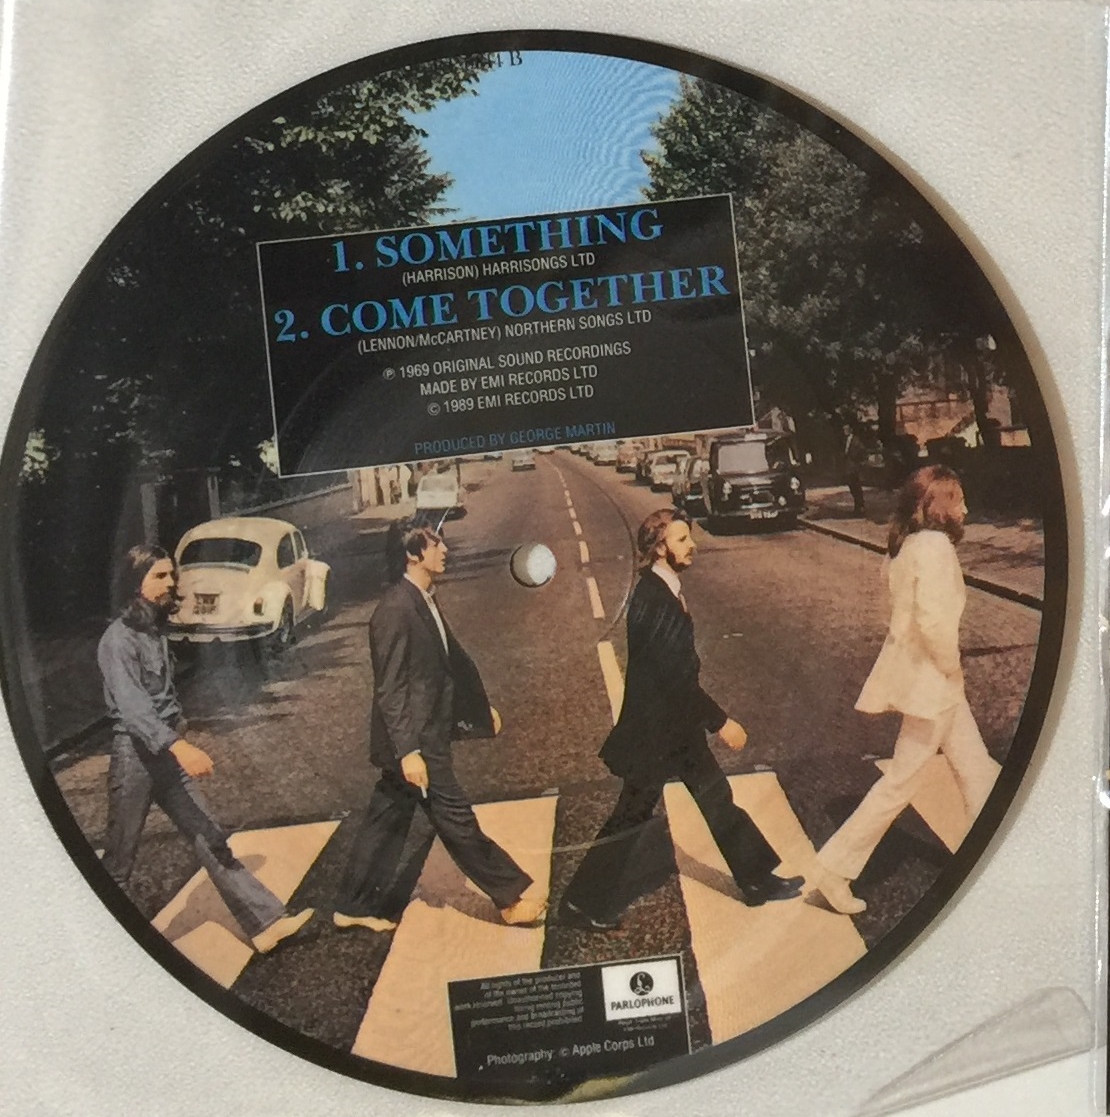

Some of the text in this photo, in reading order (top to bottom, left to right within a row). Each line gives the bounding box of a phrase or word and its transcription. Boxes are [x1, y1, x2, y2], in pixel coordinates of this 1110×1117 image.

[333, 209, 663, 272] 1. SOMETHING
[402, 252, 595, 286] (HARRISON) HARRISONGS LTD
[274, 265, 730, 342] 2. COME TOGETHER
[357, 309, 651, 354] (LENNON/McCARTNEY) NORTHERN SONGS LTD
[399, 362, 430, 378] 1969
[432, 356, 495, 375] ORIGINAL
[497, 350, 543, 368] SOUND
[546, 340, 631, 362] RECORDINGS
[420, 364, 597, 395] MADE BY EMI RECORDS LTD
[443, 397, 474, 412] 1989
[477, 394, 501, 409] EMI
[504, 387, 566, 405] RECORDS
[569, 384, 594, 399] LTD
[414, 421, 616, 454] PRODUCED BY GEORGE MARTIN
[610, 995, 674, 1010] PARLOPHONE
